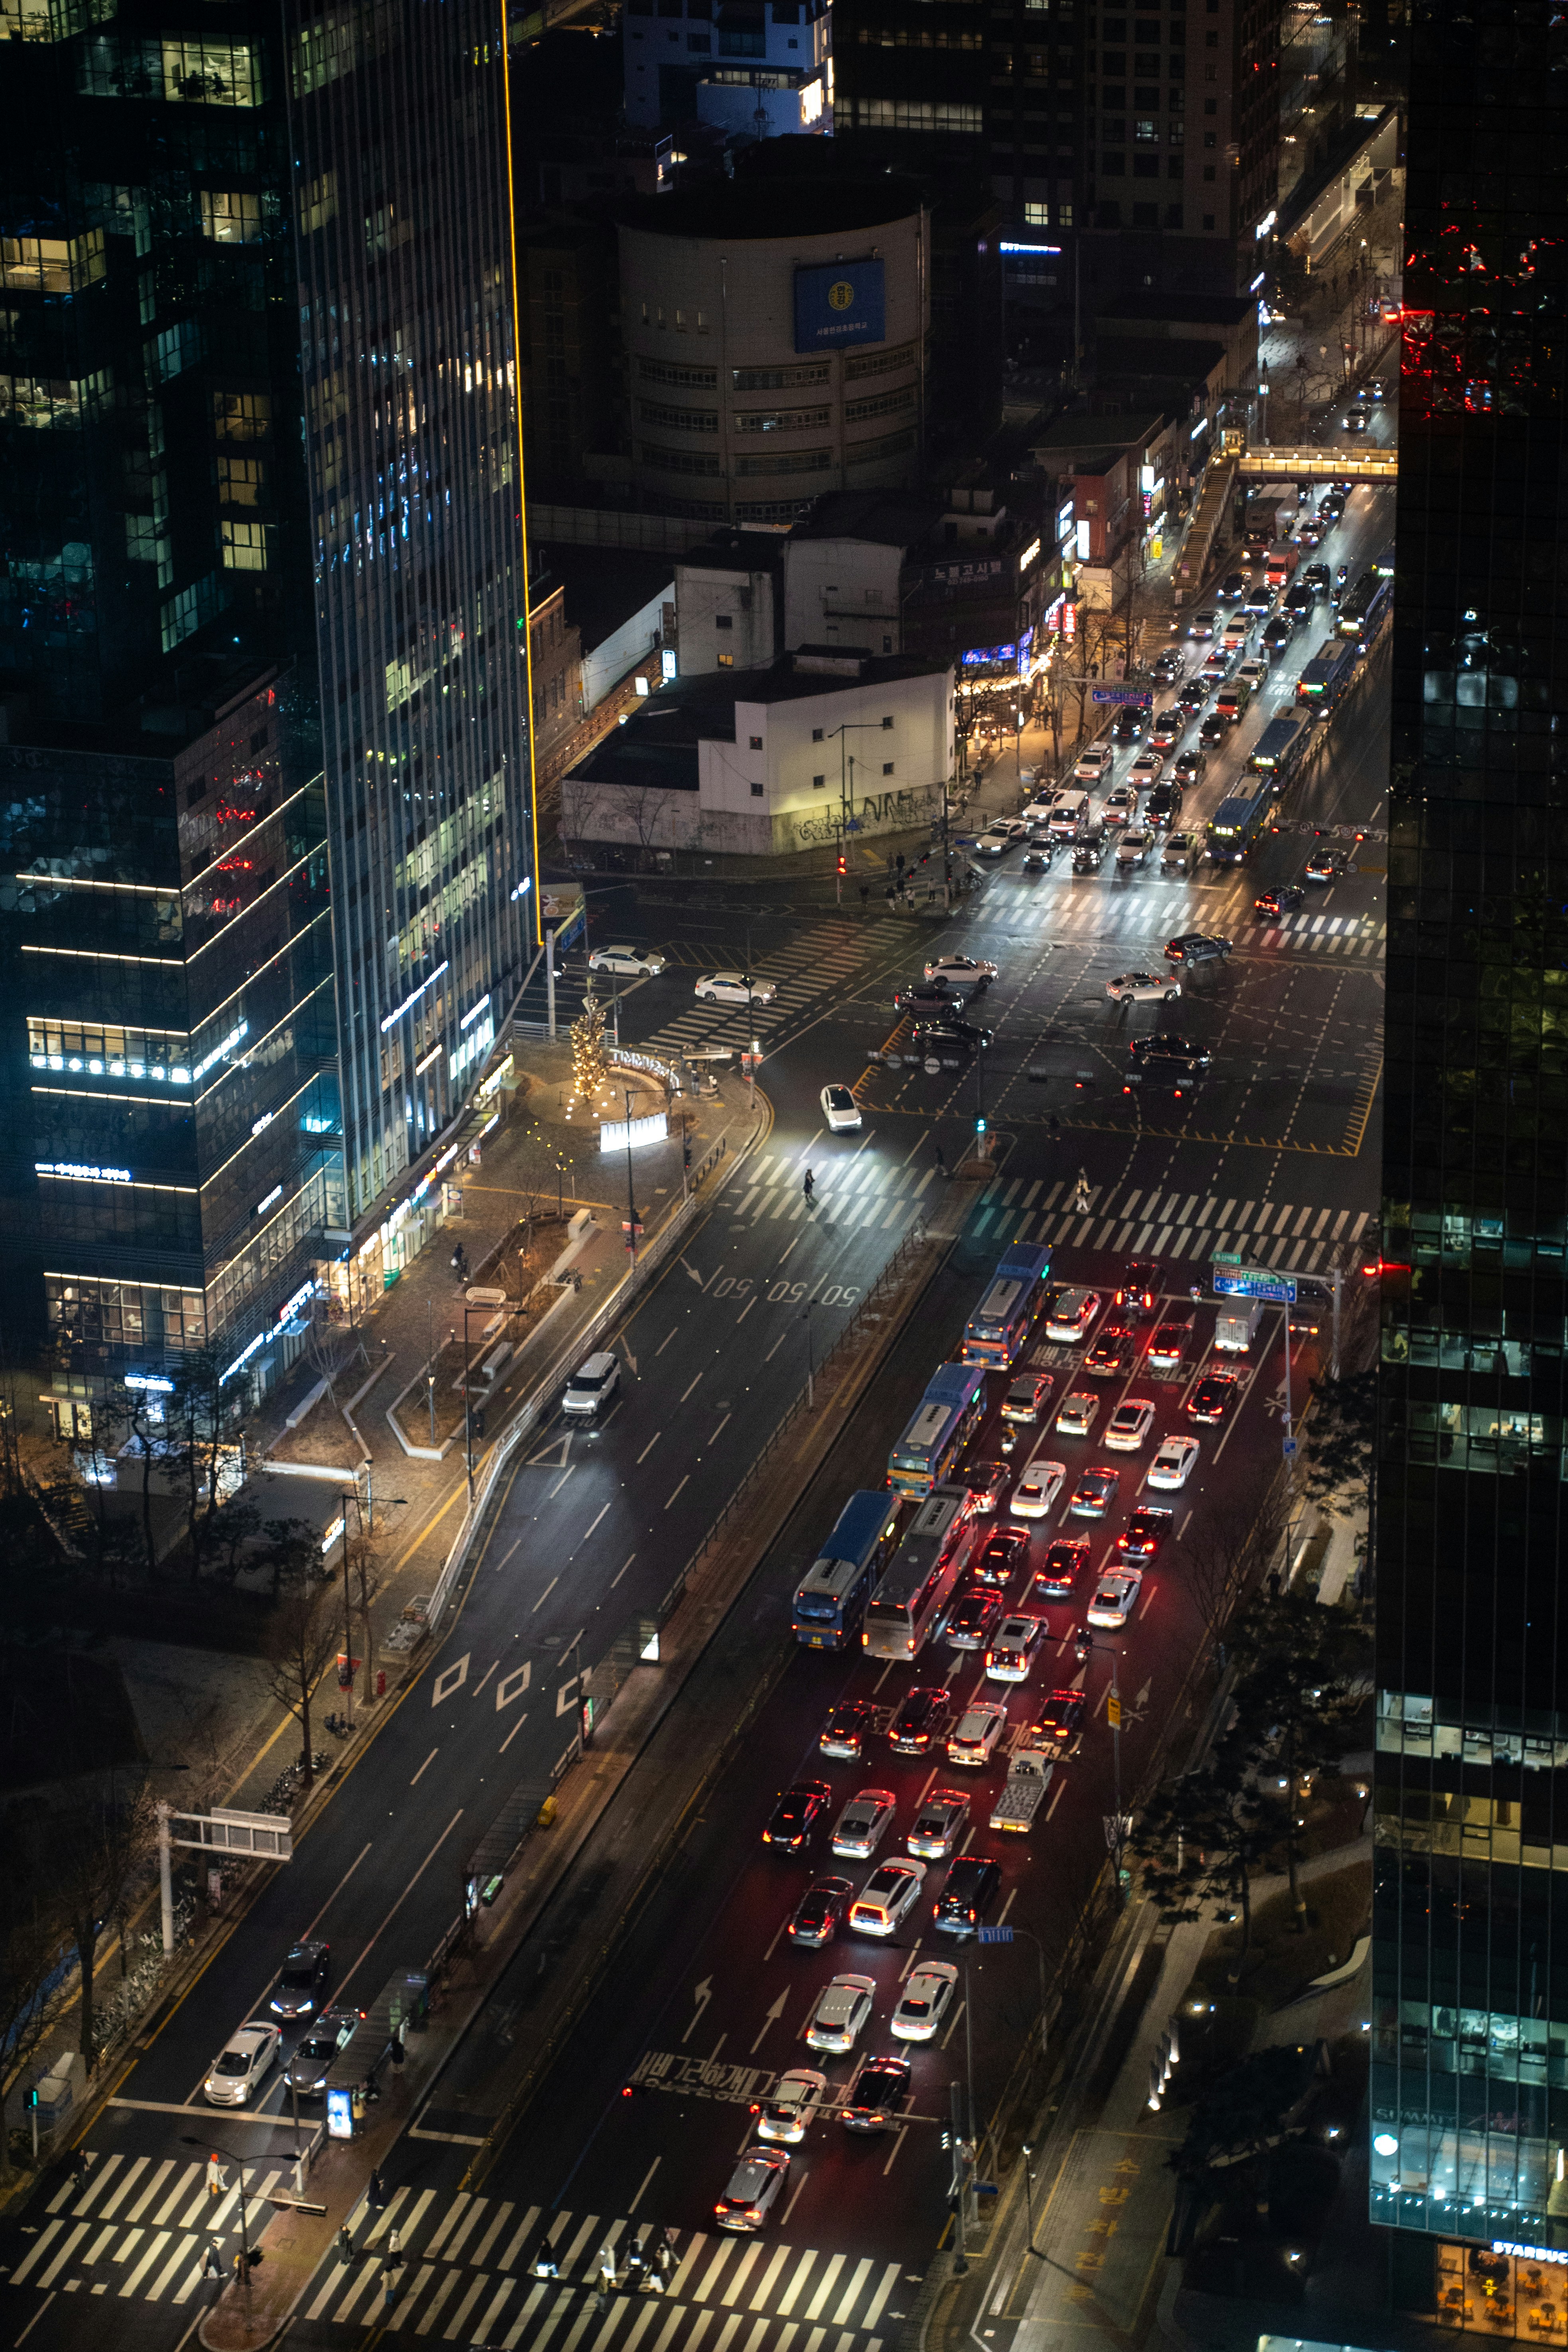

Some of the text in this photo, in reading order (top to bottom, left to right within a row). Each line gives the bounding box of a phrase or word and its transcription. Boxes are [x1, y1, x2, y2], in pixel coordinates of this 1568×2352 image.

[816, 322, 867, 336] 서울한강초등학교
[713, 1277, 754, 1299] 50
[766, 1280, 808, 1304] 50
[821, 1284, 861, 1308] 50
[1493, 2241, 1568, 2265] STARBUC
